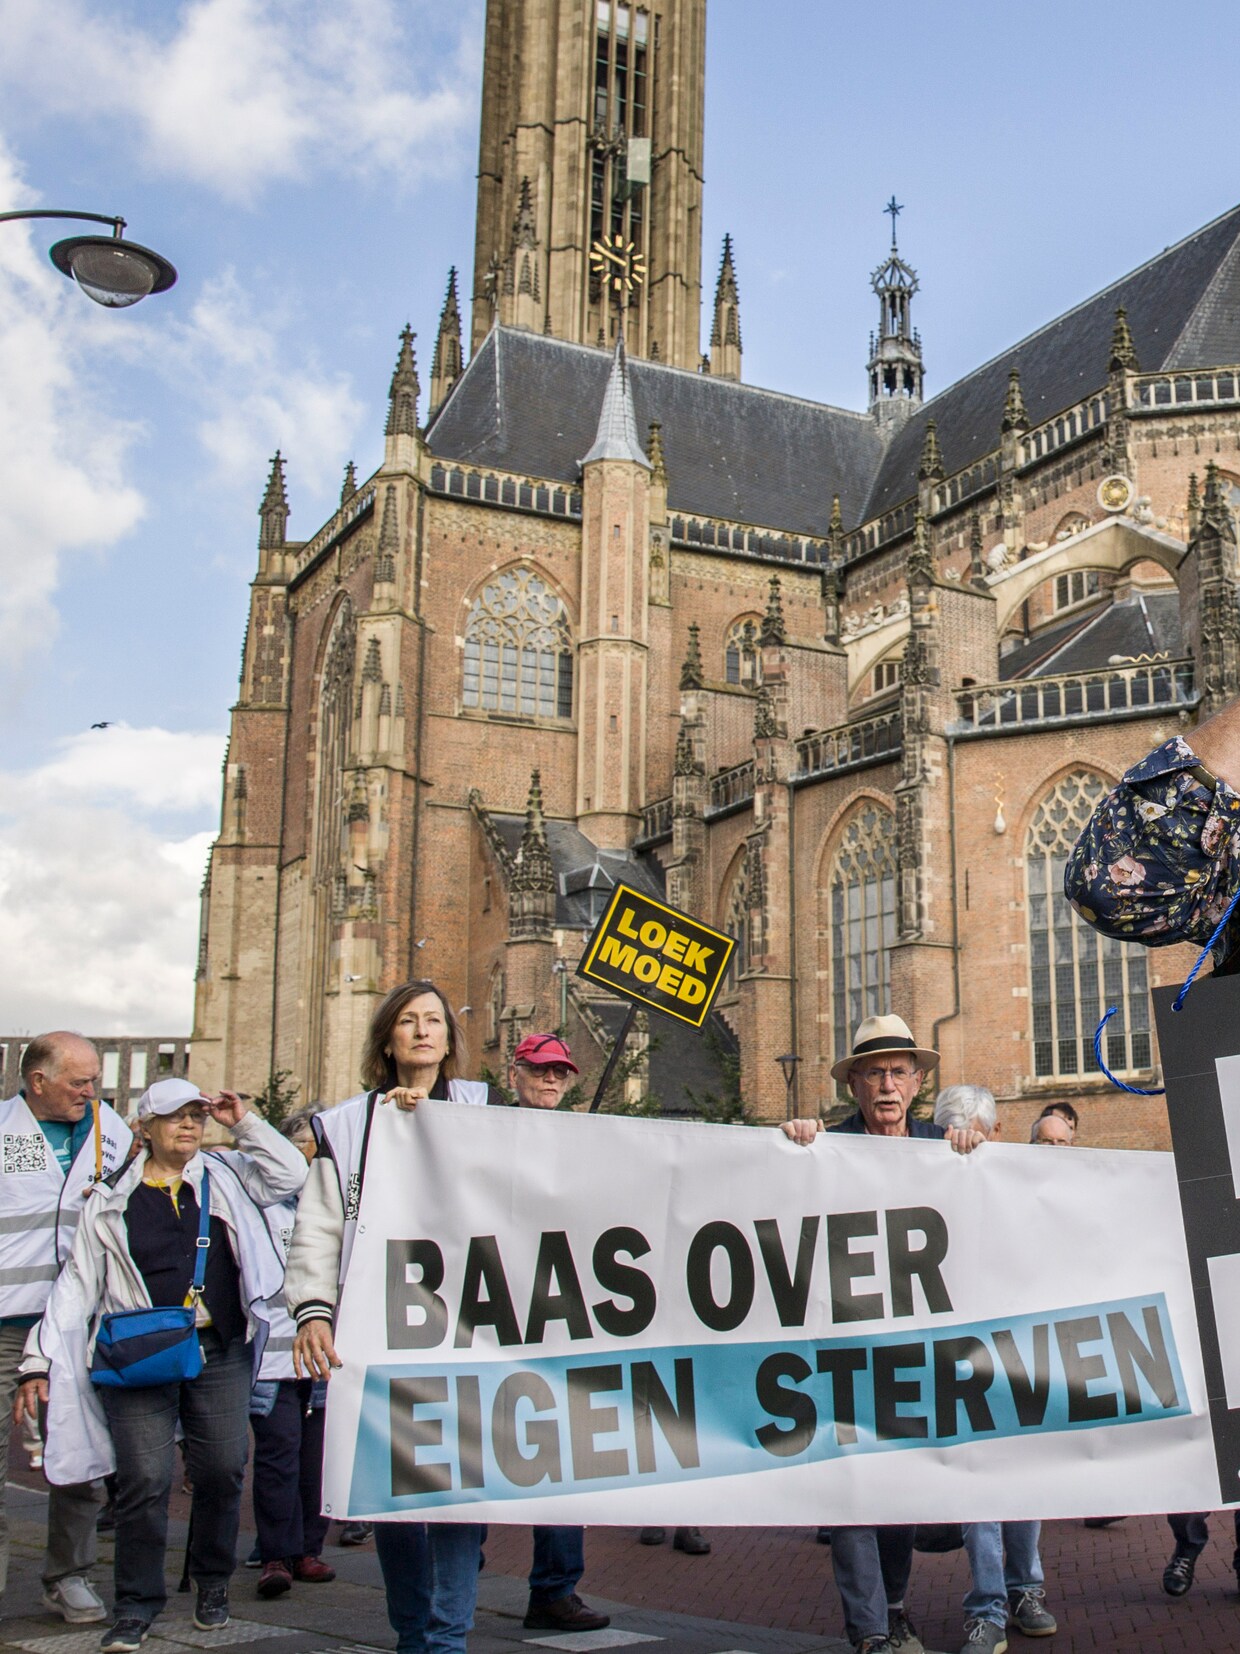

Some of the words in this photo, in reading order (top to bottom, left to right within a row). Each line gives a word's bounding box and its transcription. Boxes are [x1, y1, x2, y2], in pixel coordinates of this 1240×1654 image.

[598, 935, 707, 1005] MOED
[617, 907, 715, 975] LOEK
[386, 1226, 657, 1350] BAAS
[686, 1206, 954, 1332] OVER
[389, 1357, 701, 1497] EIGEN
[754, 1305, 1180, 1458] STERVEN
